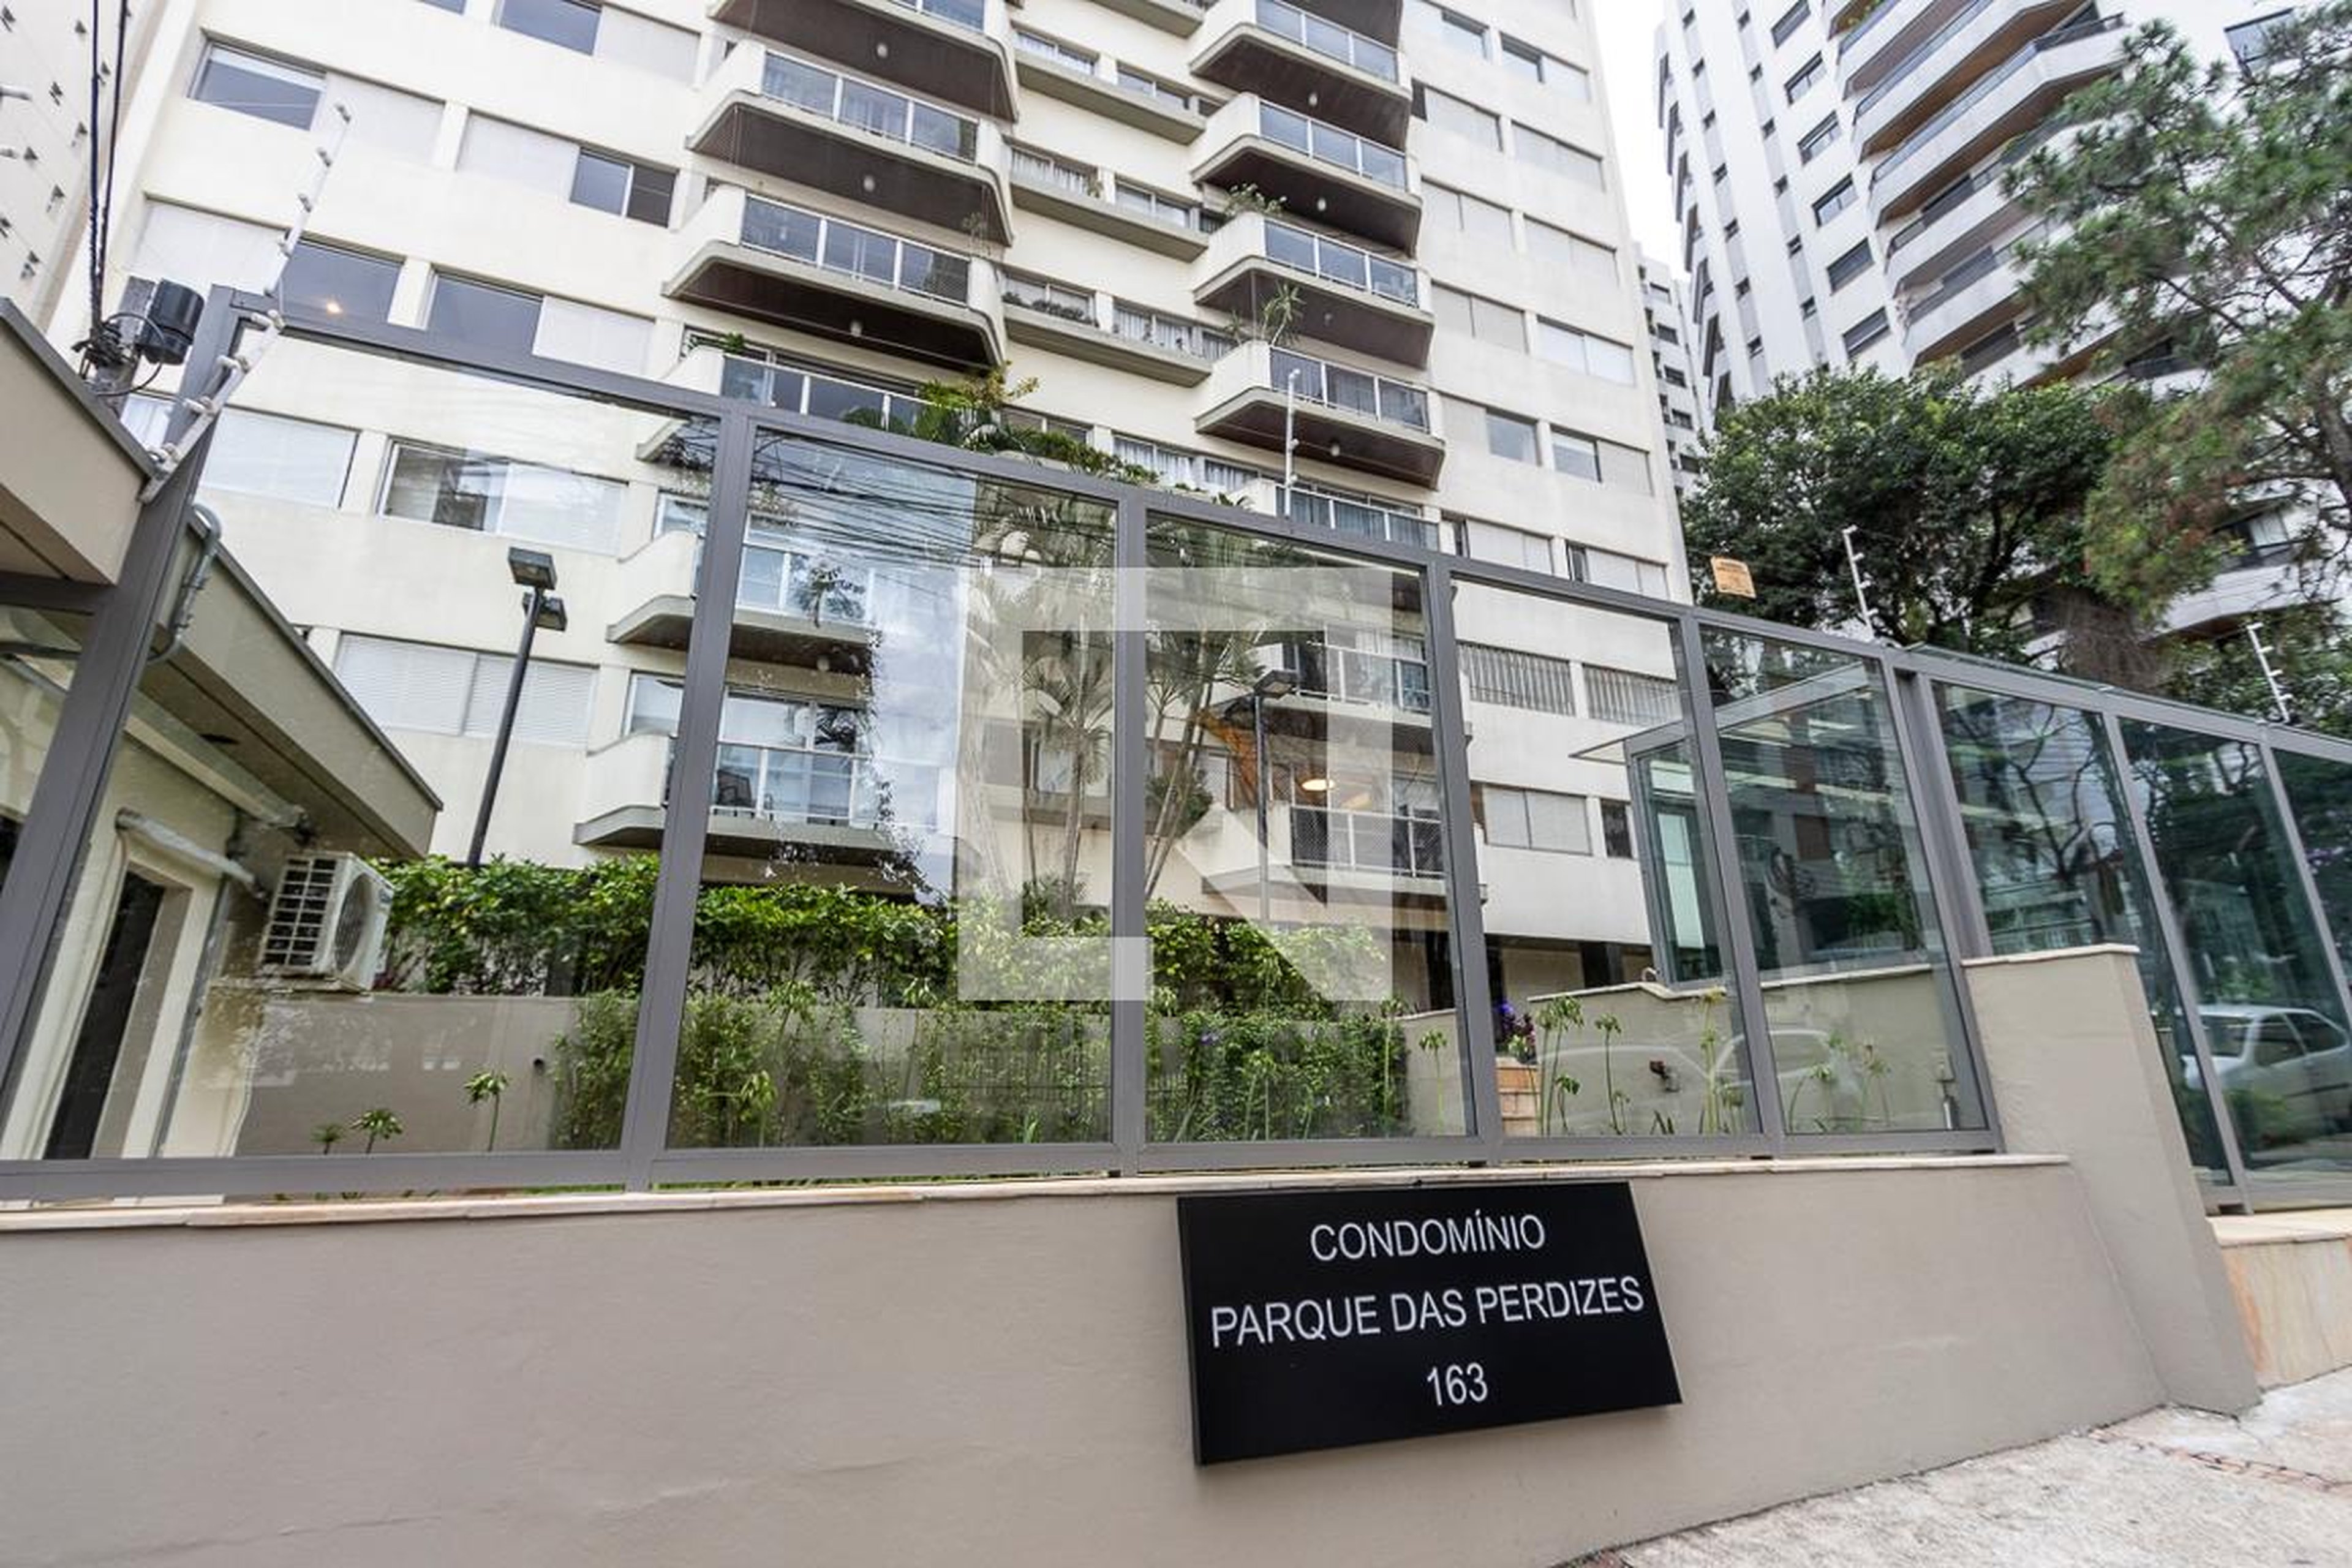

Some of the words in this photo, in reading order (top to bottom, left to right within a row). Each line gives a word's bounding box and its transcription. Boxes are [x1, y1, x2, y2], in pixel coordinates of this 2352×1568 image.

[1310, 1208, 1546, 1262] CONDOMÍNIO
[1211, 1294, 1382, 1348] PARQUE
[1390, 1288, 1468, 1332] DAS
[1476, 1276, 1645, 1324] PERDIZES
[1426, 1362, 1488, 1406] 163
